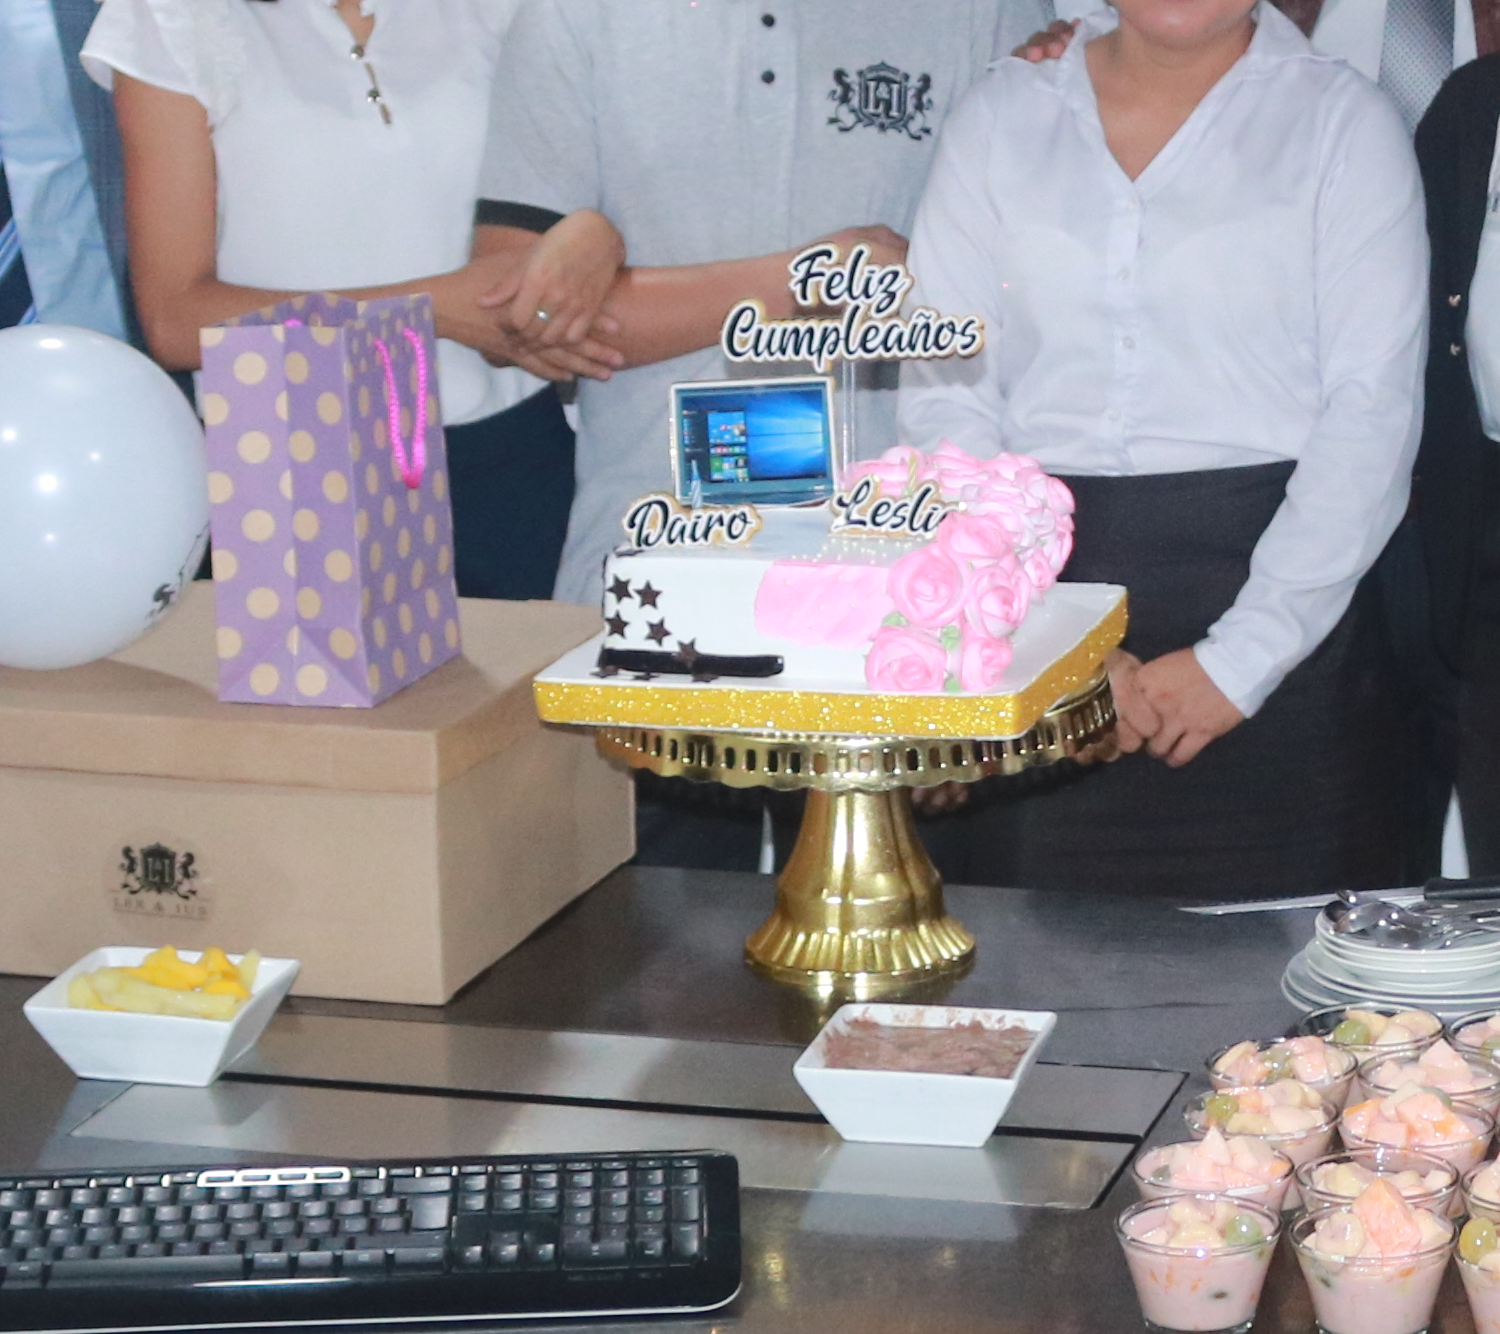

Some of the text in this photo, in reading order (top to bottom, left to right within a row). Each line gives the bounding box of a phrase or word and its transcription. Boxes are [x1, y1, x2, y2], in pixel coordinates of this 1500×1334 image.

[794, 248, 904, 312] Feliz
[725, 307, 980, 368] Cumpleaños
[626, 499, 752, 548] Dairo
[836, 479, 947, 532] Lesli
